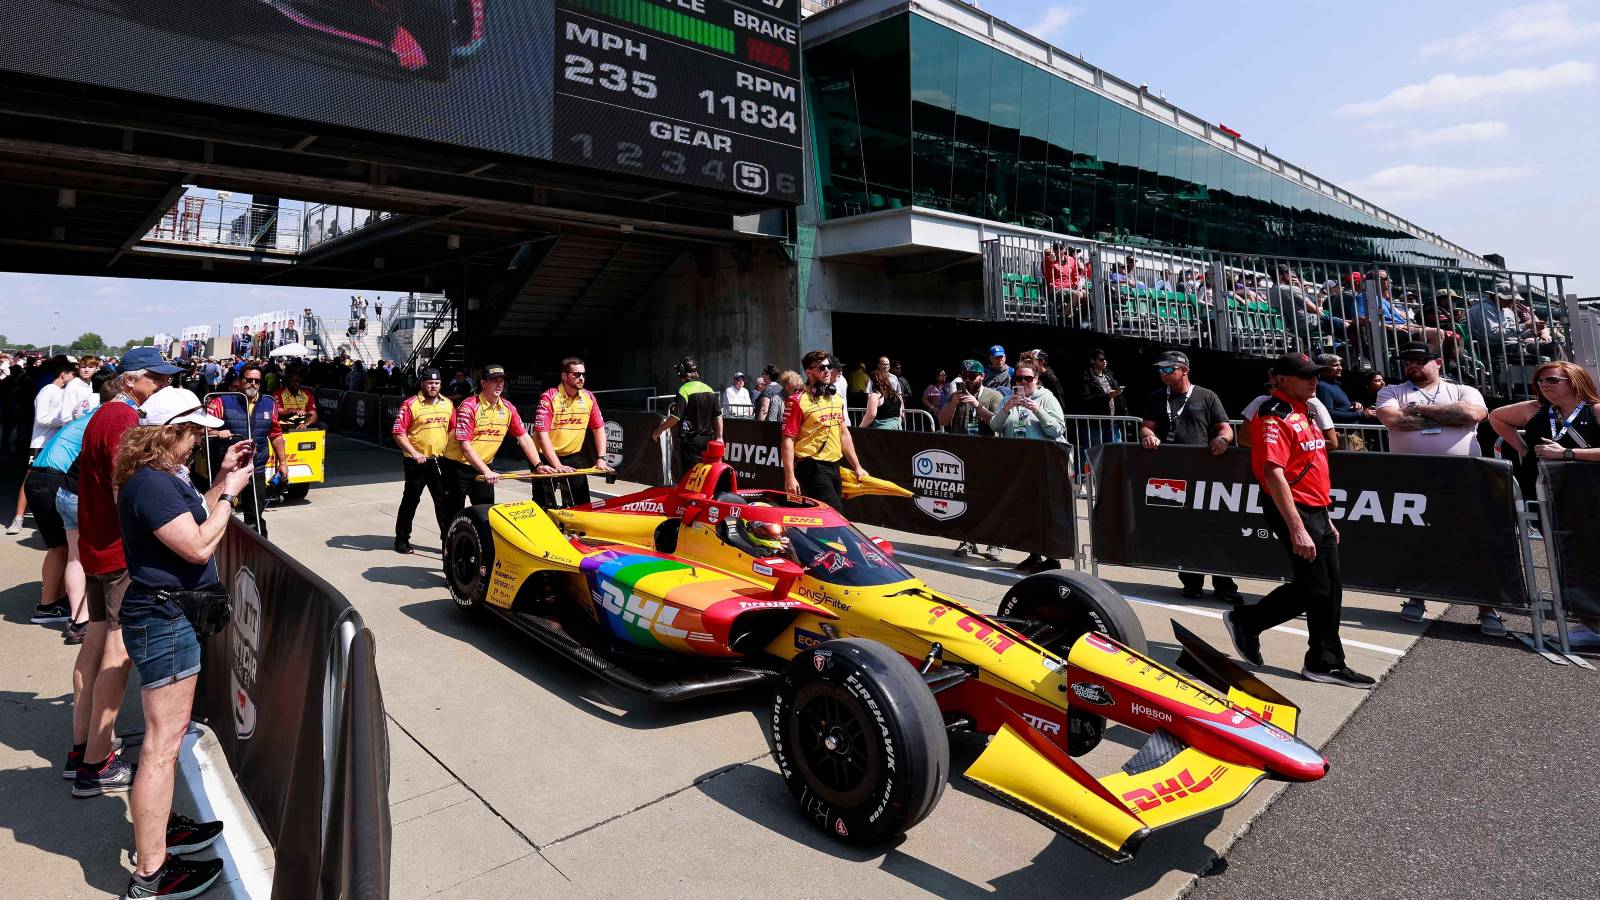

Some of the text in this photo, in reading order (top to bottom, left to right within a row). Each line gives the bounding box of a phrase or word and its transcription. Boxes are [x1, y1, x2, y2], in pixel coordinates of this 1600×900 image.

[565, 21, 647, 61] MPH
[734, 10, 797, 45] BRAKE
[564, 54, 658, 99] 235
[736, 71, 796, 102] RPM
[699, 89, 797, 134] 11834
[650, 121, 732, 153] GEAR
[570, 134, 796, 195] 1 2 3 4 5 6
[559, 418, 584, 426] DHL
[685, 463, 713, 492] 28
[935, 462, 960, 475] NTT
[913, 477, 965, 493] INDYCAR
[923, 489, 954, 498] SERIES
[621, 499, 665, 513] HONDA
[1193, 480, 1427, 527] INCAR
[601, 579, 689, 639] DHL
[738, 601, 801, 610] Firestone
[1071, 683, 1099, 696] ROUGH
[1075, 690, 1100, 701] RIDER
[846, 675, 896, 773] FIREHAWK
[1131, 703, 1172, 723] HOBSON
[773, 695, 793, 780] Firestone
[1122, 768, 1214, 812] DHL
